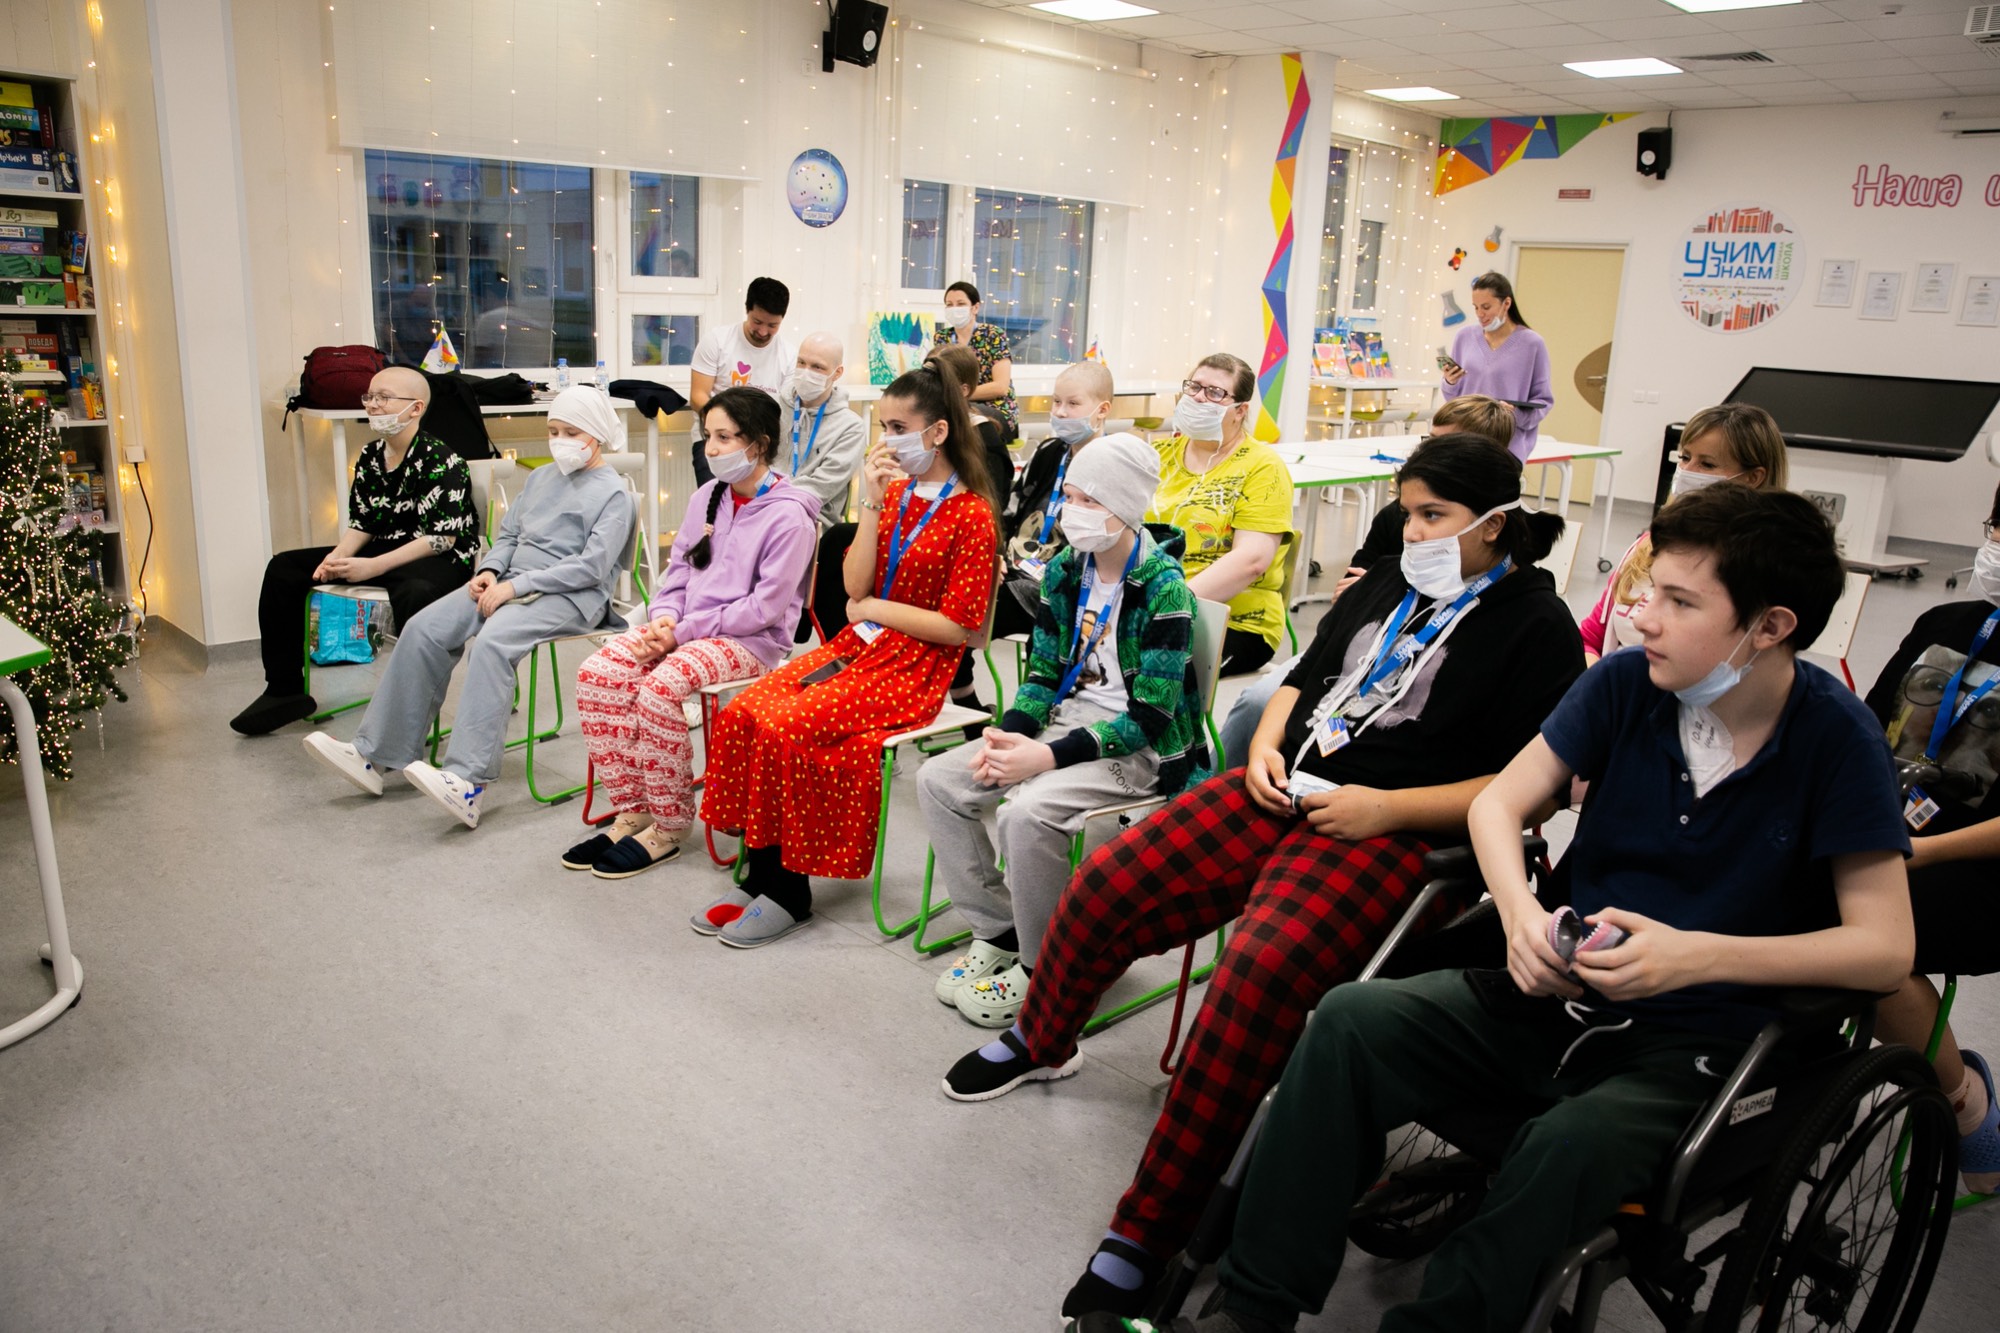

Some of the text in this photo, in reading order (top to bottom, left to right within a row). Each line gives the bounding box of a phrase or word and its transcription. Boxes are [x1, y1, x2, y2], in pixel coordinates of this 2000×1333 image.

[1852, 164, 1962, 208] Наша
[1683, 241, 1776, 277] УЧИМ
[1781, 242, 1794, 280] ШКОЛА
[28, 338, 54, 346] ПОБЕДА
[1108, 762, 1137, 796] SPORT
[1743, 1094, 1774, 1115] АРМЕД
